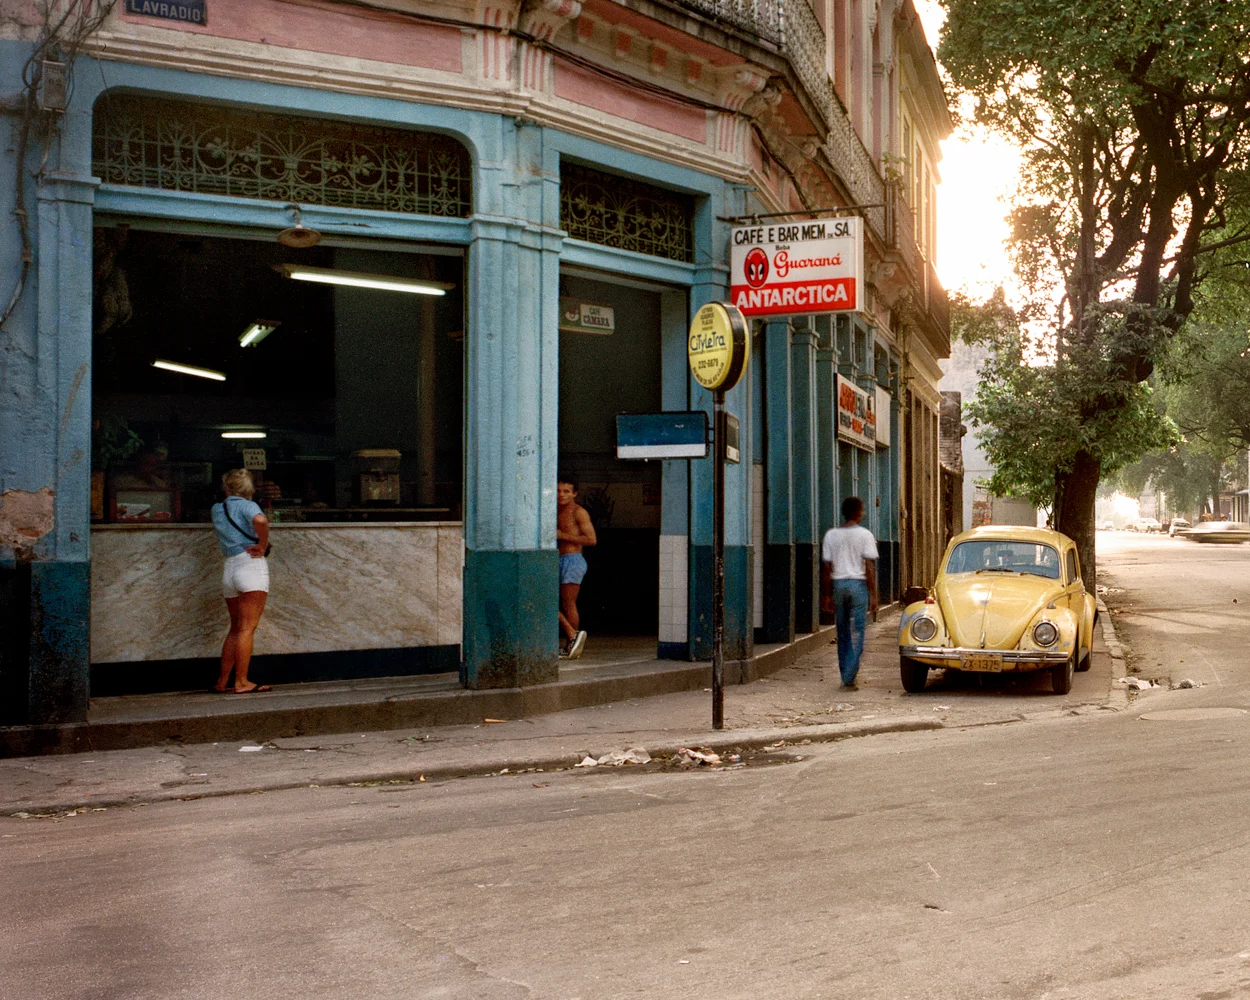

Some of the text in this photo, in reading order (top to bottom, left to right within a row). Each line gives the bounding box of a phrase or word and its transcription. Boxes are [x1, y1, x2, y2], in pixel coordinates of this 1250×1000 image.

[734, 225, 764, 245] CAFÉ
[768, 228, 775, 242] E
[778, 226, 799, 242] BAR
[802, 224, 825, 240] MEM
[773, 251, 842, 277] Guaraná
[736, 283, 848, 308] ANTARCTICA
